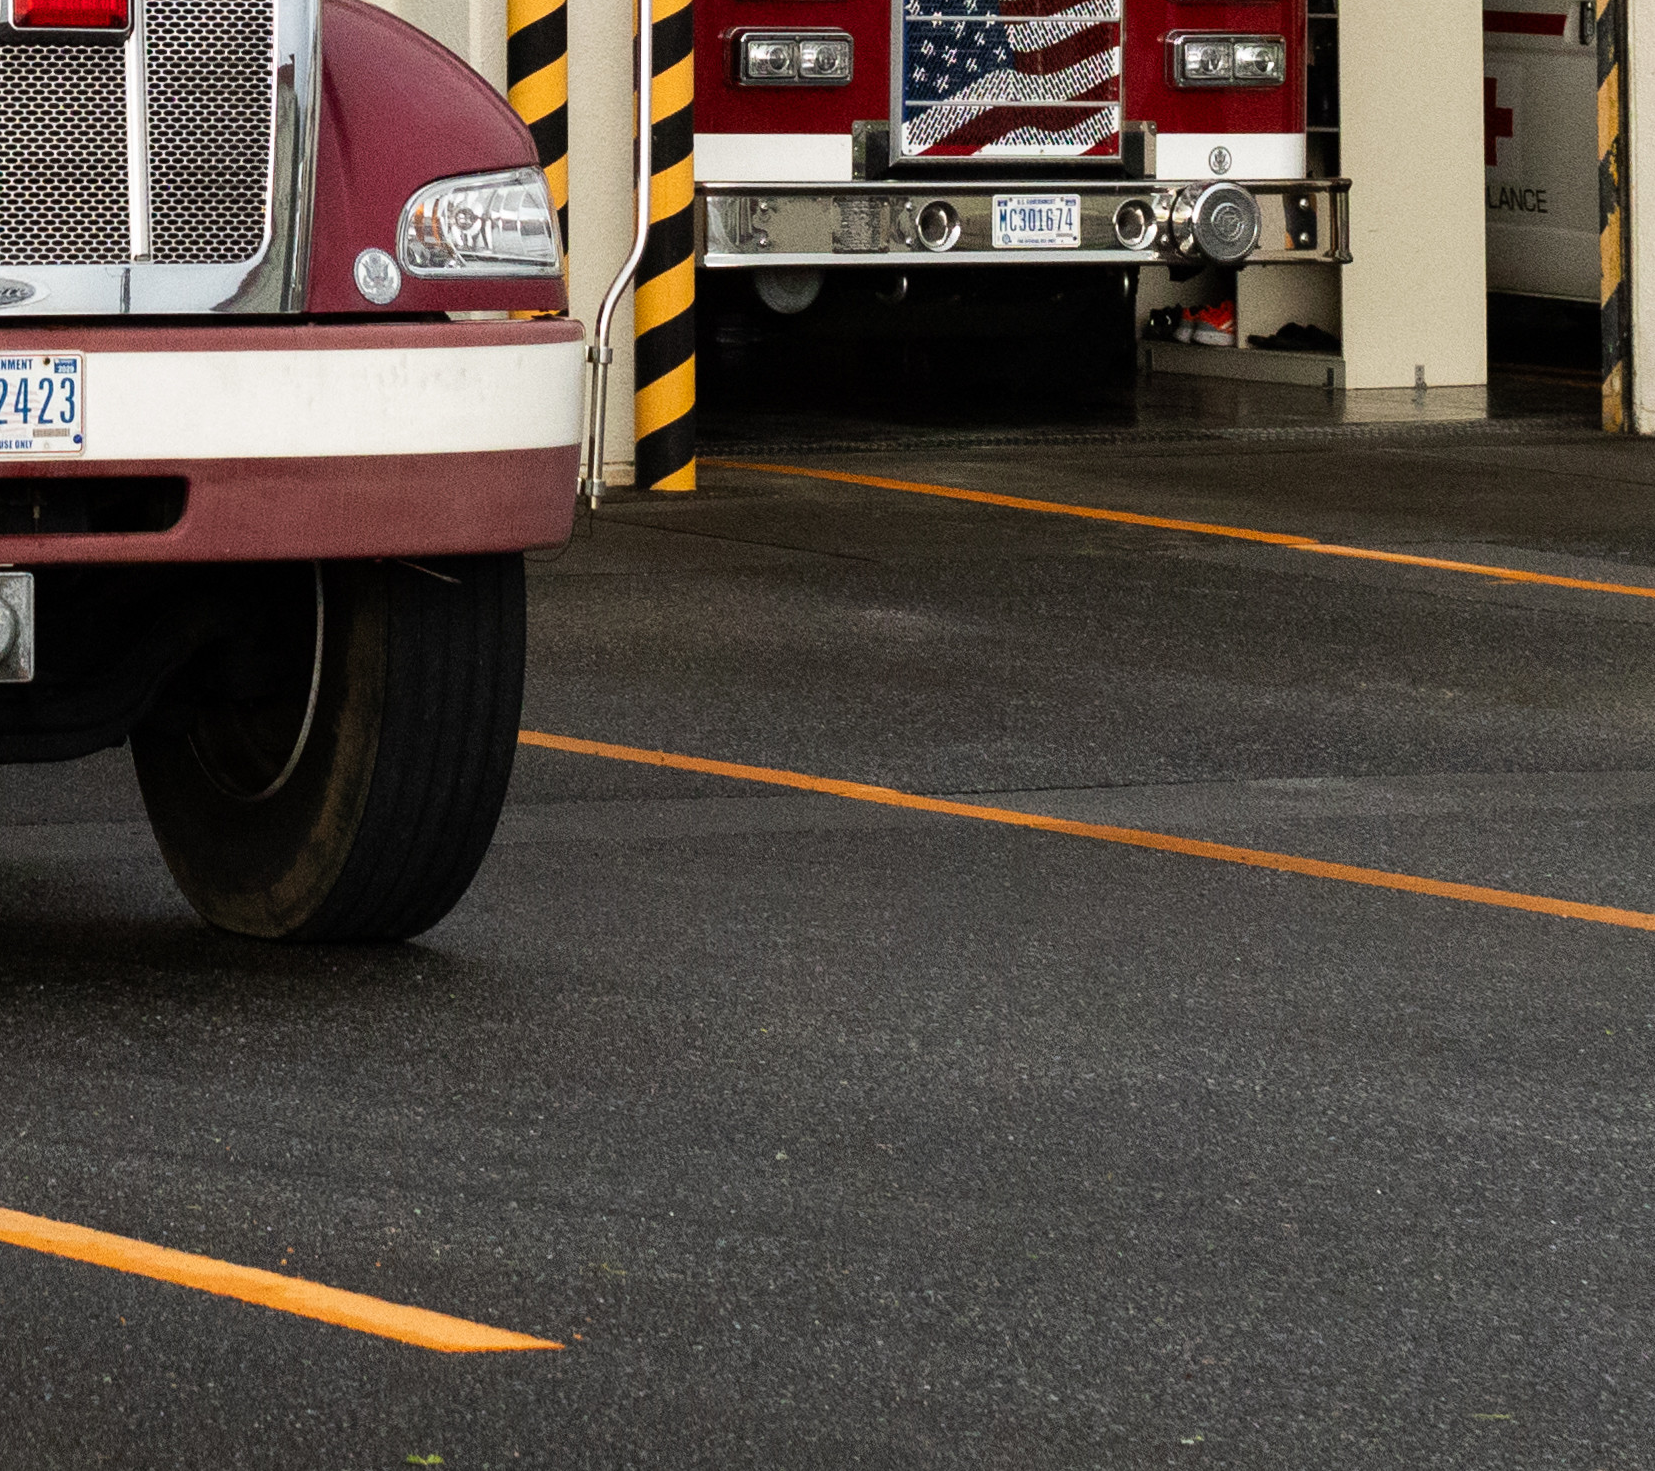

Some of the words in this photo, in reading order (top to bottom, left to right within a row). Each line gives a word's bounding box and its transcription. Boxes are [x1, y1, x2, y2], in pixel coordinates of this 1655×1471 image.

[1000, 207, 1073, 232] MC301674
[0, 440, 13, 449] USE
[15, 440, 33, 449] ONLY
